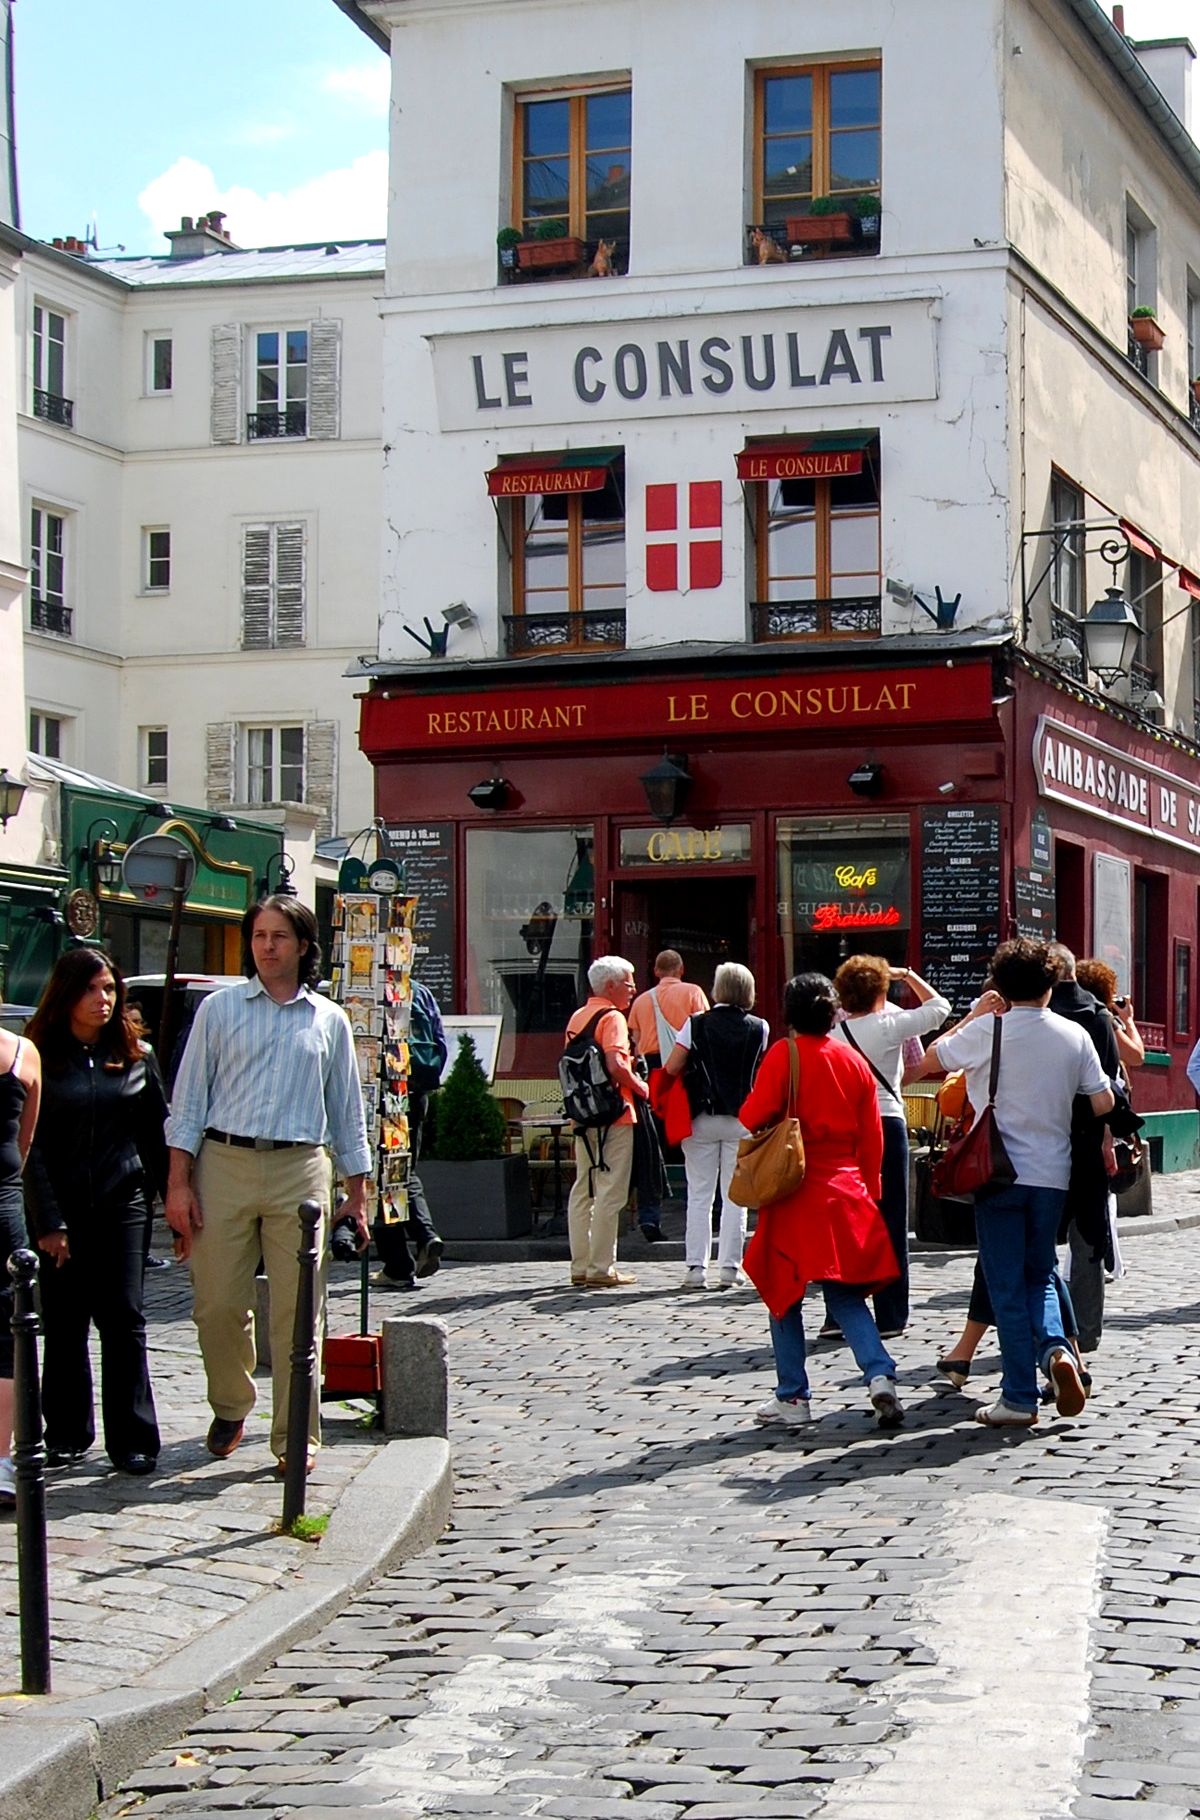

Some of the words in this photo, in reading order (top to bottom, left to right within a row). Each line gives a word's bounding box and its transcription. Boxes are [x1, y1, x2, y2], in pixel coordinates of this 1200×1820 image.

[471, 350, 534, 410] LE
[574, 325, 892, 402] CONSULAT
[501, 470, 592, 494] RESTAURANT
[750, 459, 768, 477] LE
[775, 454, 851, 476] CONSULAT
[428, 704, 587, 735] RESTAURANT
[667, 694, 710, 722] LE
[730, 683, 917, 718] CONSULAT
[1043, 737, 1148, 816] AMBASSADE
[1160, 787, 1176, 826] DE
